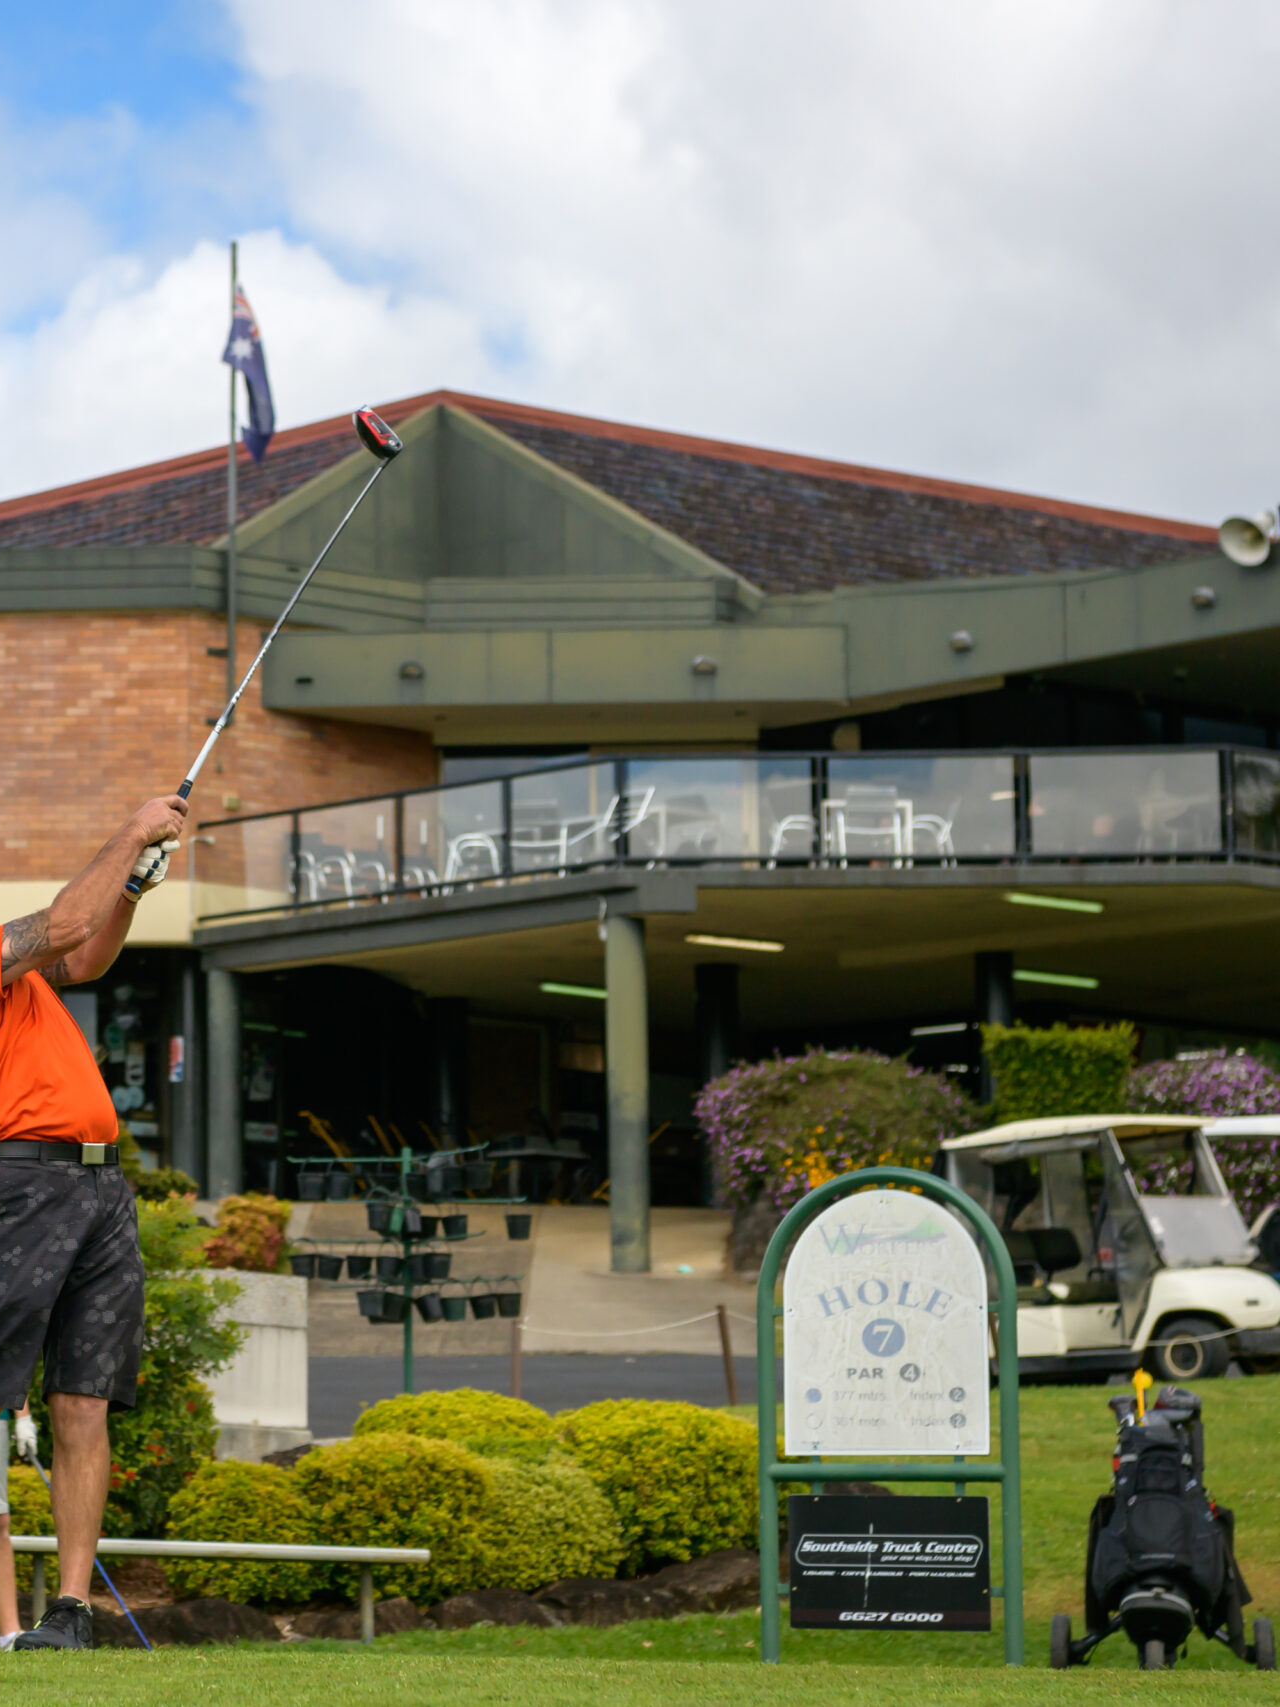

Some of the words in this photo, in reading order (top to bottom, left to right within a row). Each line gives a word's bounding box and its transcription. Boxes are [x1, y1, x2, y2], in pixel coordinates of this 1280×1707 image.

[817, 1278, 953, 1319] HOLE
[872, 1324, 895, 1352] 7
[847, 1367, 884, 1379] PAR
[903, 1365, 917, 1380] 4
[800, 1541, 879, 1553] Southside
[881, 1541, 922, 1553] Truck
[924, 1541, 978, 1554] Centre
[839, 1611, 889, 1621] 6627
[890, 1612, 944, 1622] 6000
